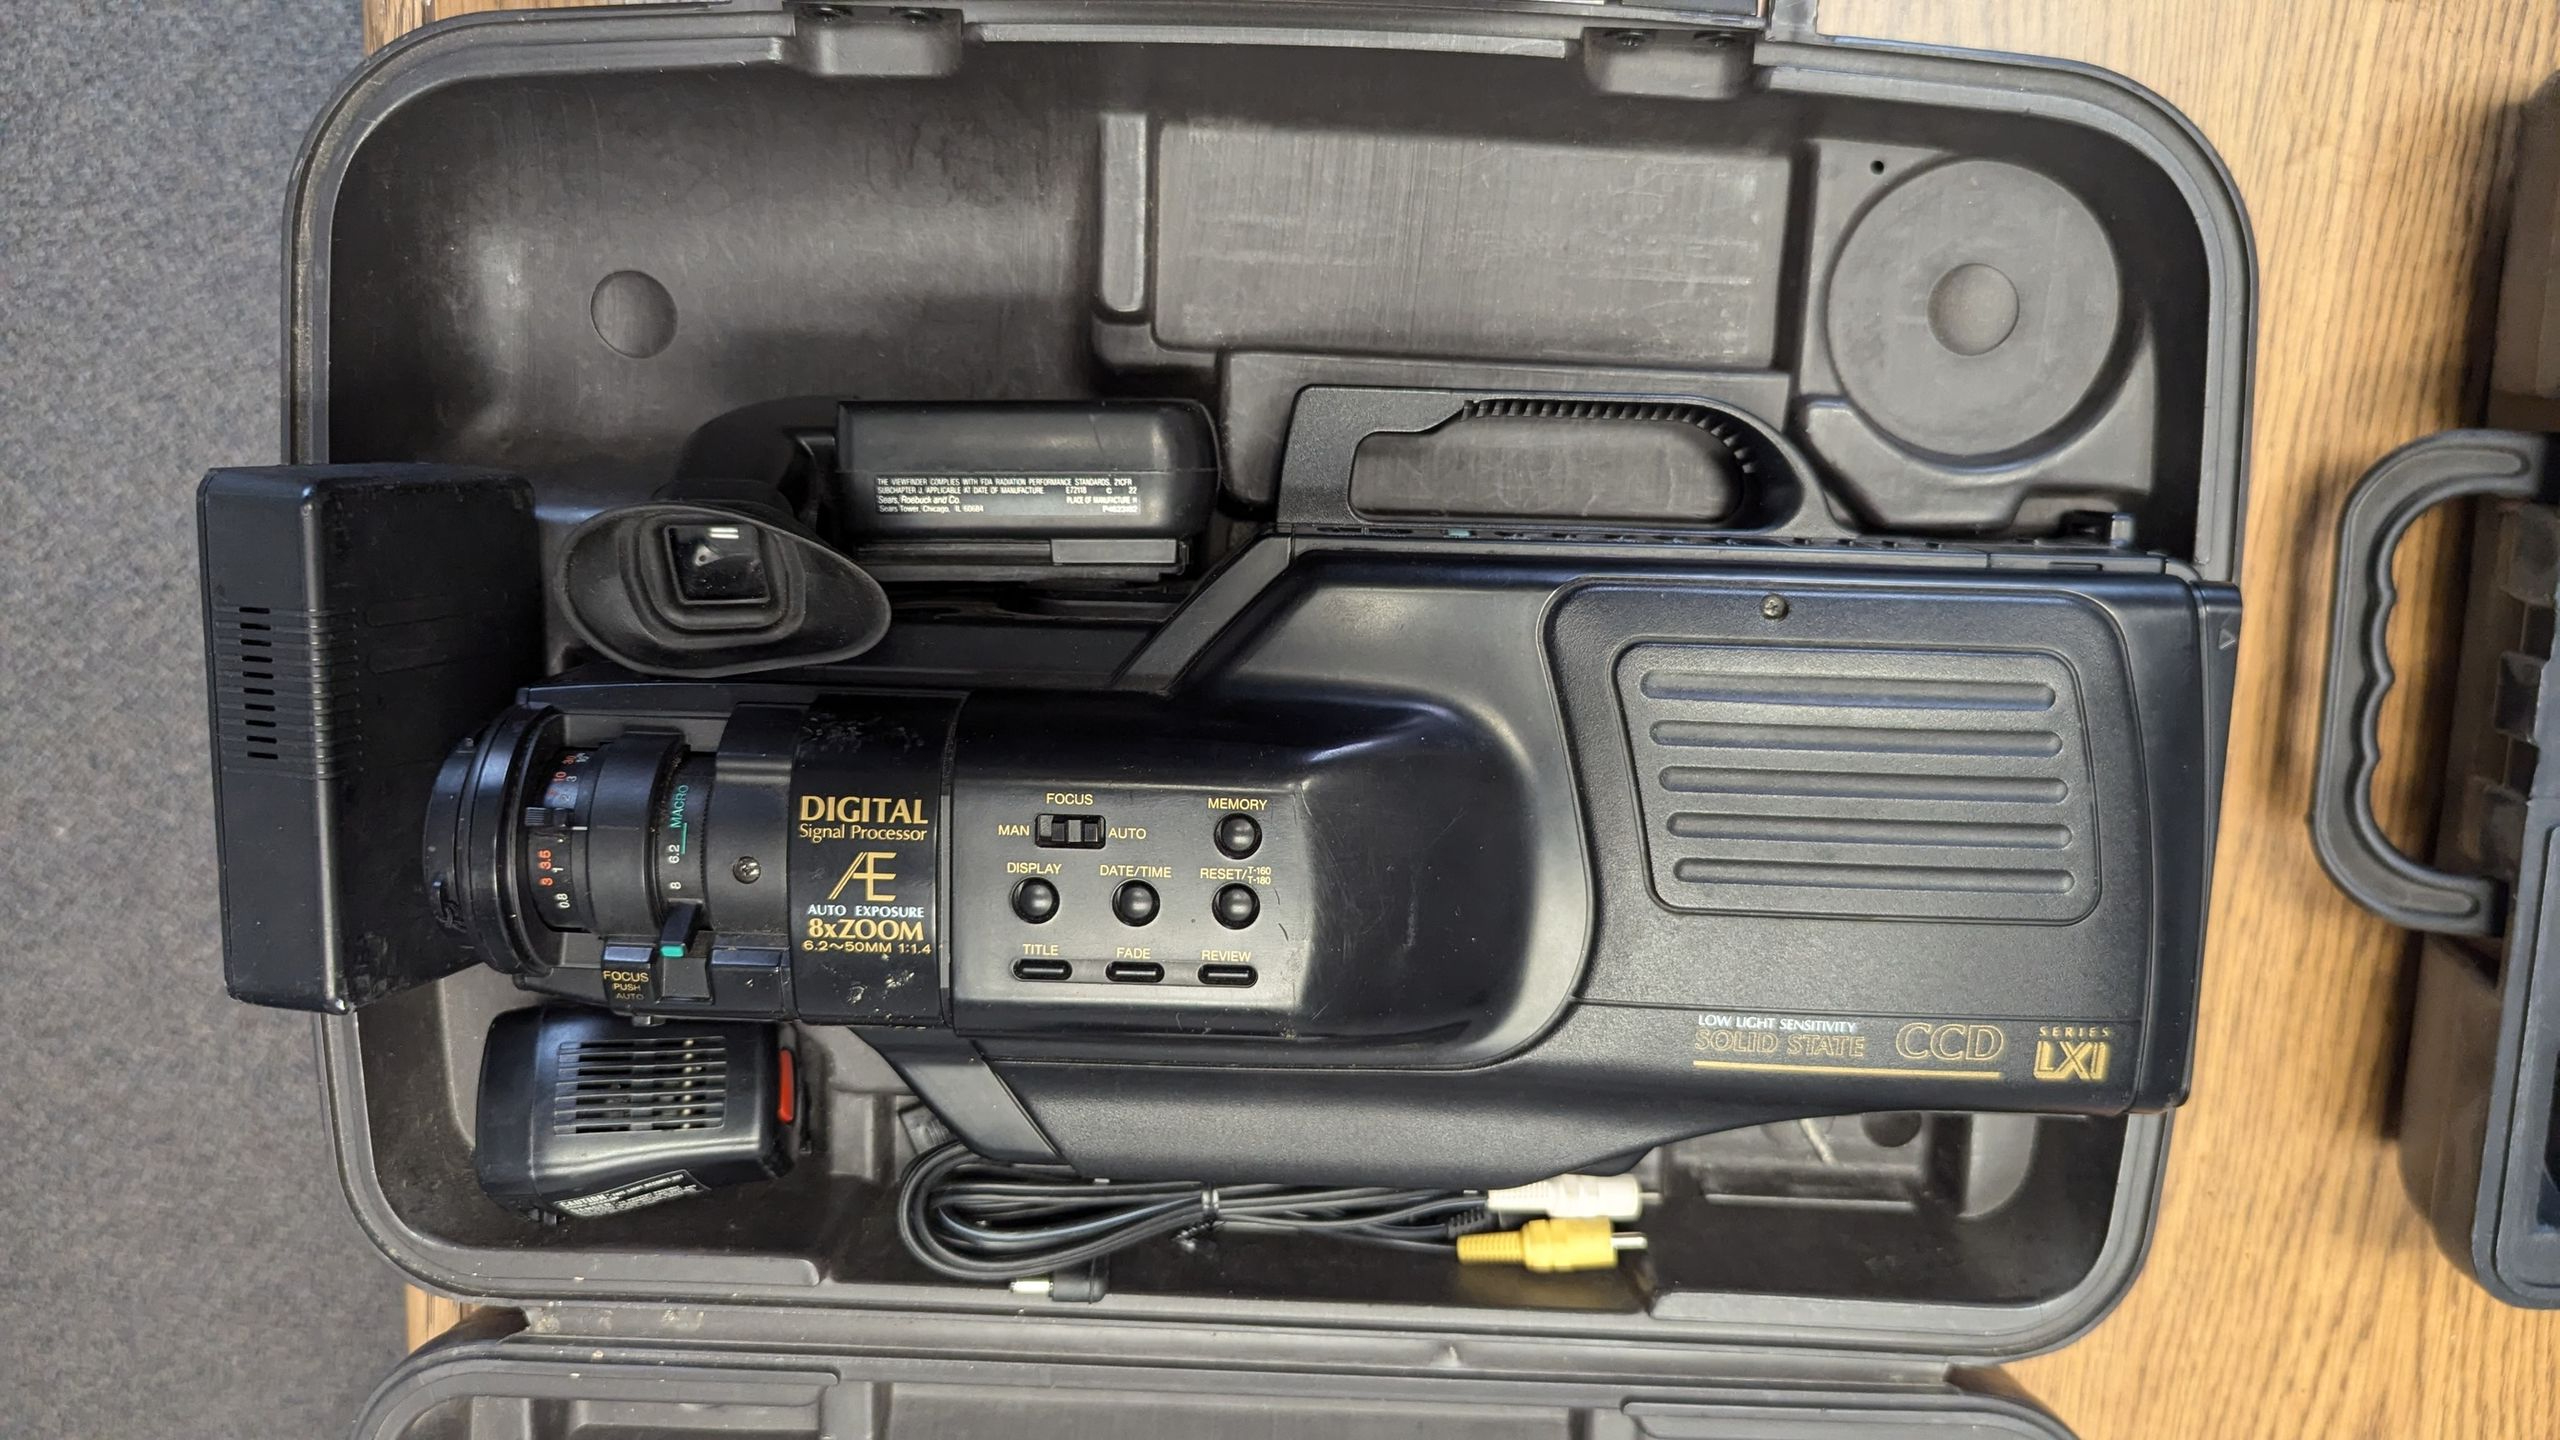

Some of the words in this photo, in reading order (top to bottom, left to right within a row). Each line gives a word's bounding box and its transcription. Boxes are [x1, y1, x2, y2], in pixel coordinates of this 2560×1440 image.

[877, 478, 889, 487] THE
[891, 478, 928, 487] VIEWFINDER
[930, 478, 960, 487] COMPLIES
[962, 478, 979, 487] WITH
[980, 478, 993, 487] FDA
[995, 478, 1027, 487] RADIATION
[1028, 478, 1072, 487] PERFORMANCE
[877, 486, 916, 495] SUBCHAPTER
[926, 486, 961, 495] APPLICABLE
[963, 486, 971, 495] AT
[973, 486, 988, 495] DATE
[990, 486, 999, 495] OF
[1128, 486, 1137, 495] 22
[901, 495, 932, 504] Roebuck
[933, 495, 947, 504] and
[1046, 793, 1094, 806] FOCUS
[1207, 798, 1268, 811] MEMORY
[669, 784, 689, 829] MACRO
[800, 796, 928, 824] DIGITAL
[800, 823, 845, 843] Signal
[851, 825, 927, 841] Processor
[998, 824, 1030, 836] MAN
[1108, 828, 1147, 840] AUTO
[668, 844, 681, 864] 6.2
[1007, 862, 1062, 875] DISPLAY
[1100, 865, 1172, 878] DATE/TIME
[669, 881, 682, 890] 8
[554, 893, 570, 909] 0.8
[807, 904, 847, 916] AUTO
[855, 905, 925, 918] EXPOSURE
[808, 918, 924, 941] 8xZOOM
[898, 943, 932, 954] 1:1.4
[1023, 944, 1059, 956] TITLE
[1116, 948, 1151, 959] FADE
[1202, 950, 1252, 962] REVIEW
[602, 970, 649, 982] FOCUS
[613, 982, 641, 991] PUSH
[616, 992, 644, 1001] AUTO
[1698, 1014, 1732, 1027] LOW
[1736, 1016, 1776, 1029] LIGHT
[1779, 1019, 1857, 1033] SENSITIVITY
[2038, 1026, 2110, 1038] SERIES
[1695, 1029, 1779, 1053] SOLID
[1787, 1034, 1866, 1057] STATE
[1896, 1022, 2005, 1061] CCD
